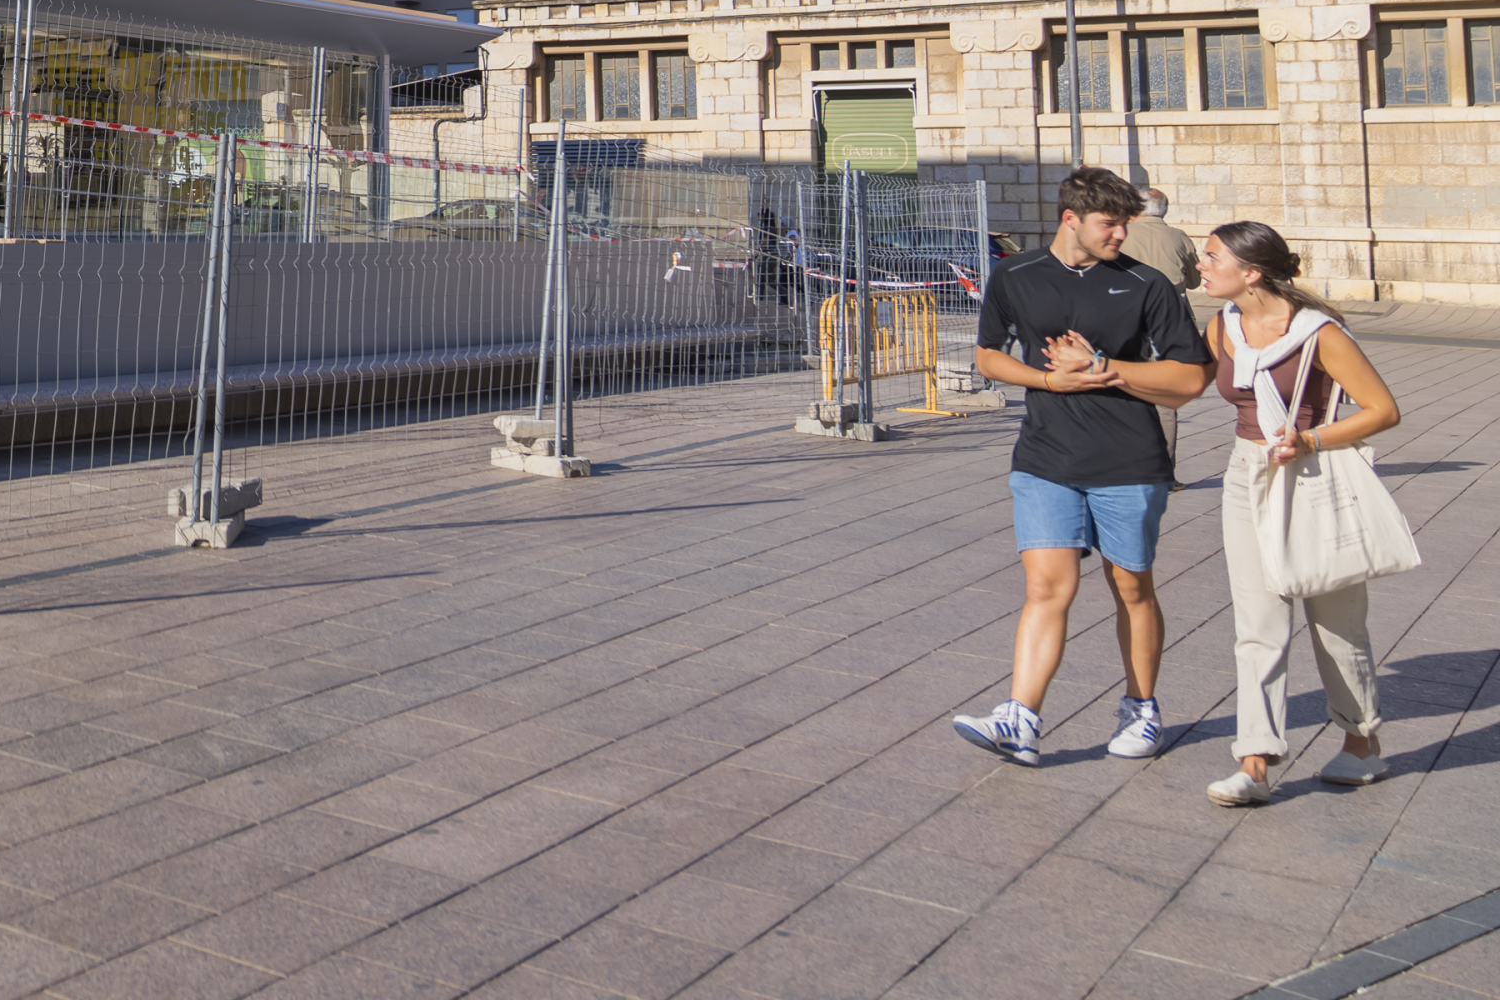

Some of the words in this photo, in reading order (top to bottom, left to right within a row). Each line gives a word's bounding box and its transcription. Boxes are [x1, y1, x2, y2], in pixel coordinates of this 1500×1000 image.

[119, 49, 156, 95] DE
[166, 54, 247, 103] FINCA
[842, 143, 899, 159] GASULL
